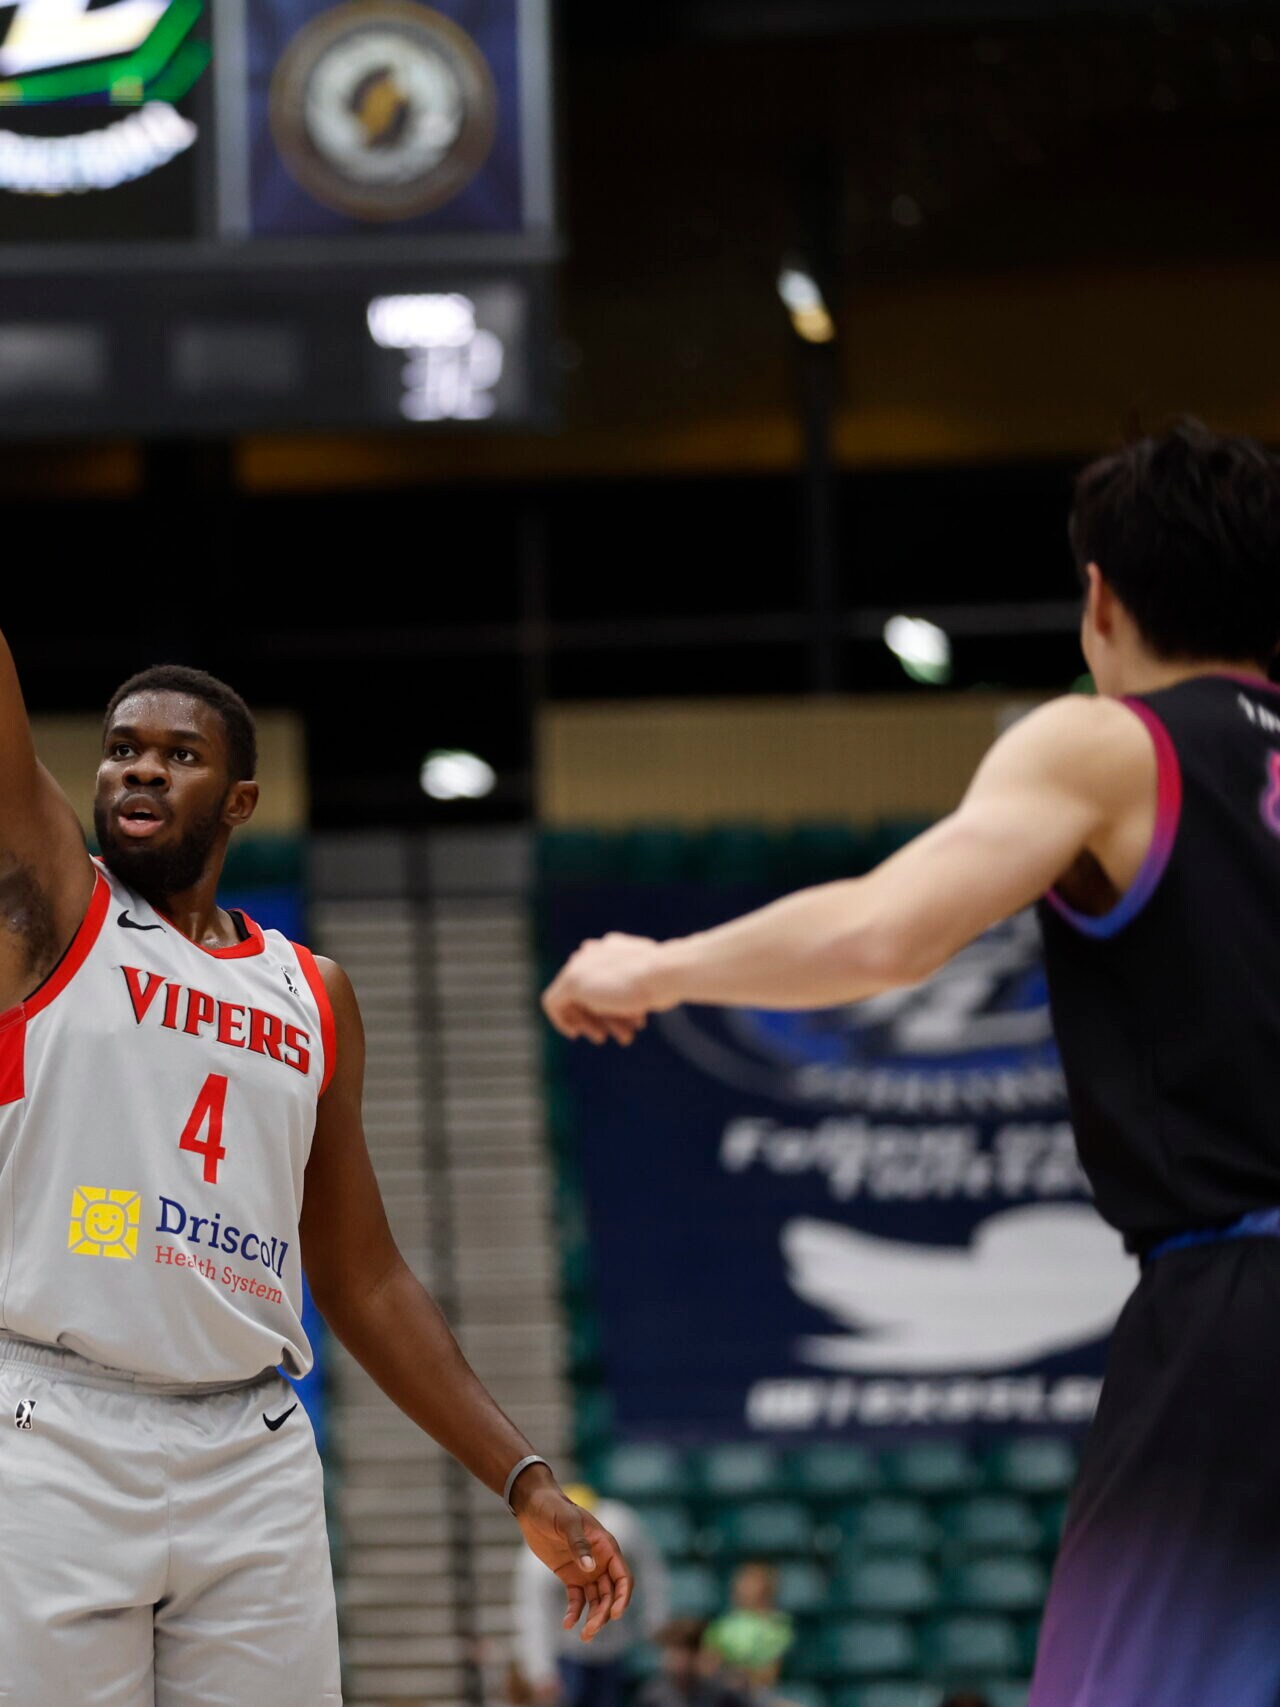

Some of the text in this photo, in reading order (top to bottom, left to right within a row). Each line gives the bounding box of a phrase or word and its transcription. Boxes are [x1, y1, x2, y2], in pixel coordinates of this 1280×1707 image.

[119, 965, 311, 1077] VIPERS
[179, 1073, 228, 1185] 4
[154, 1245, 284, 1304] Health System
[155, 1195, 290, 1279] Driscoll
